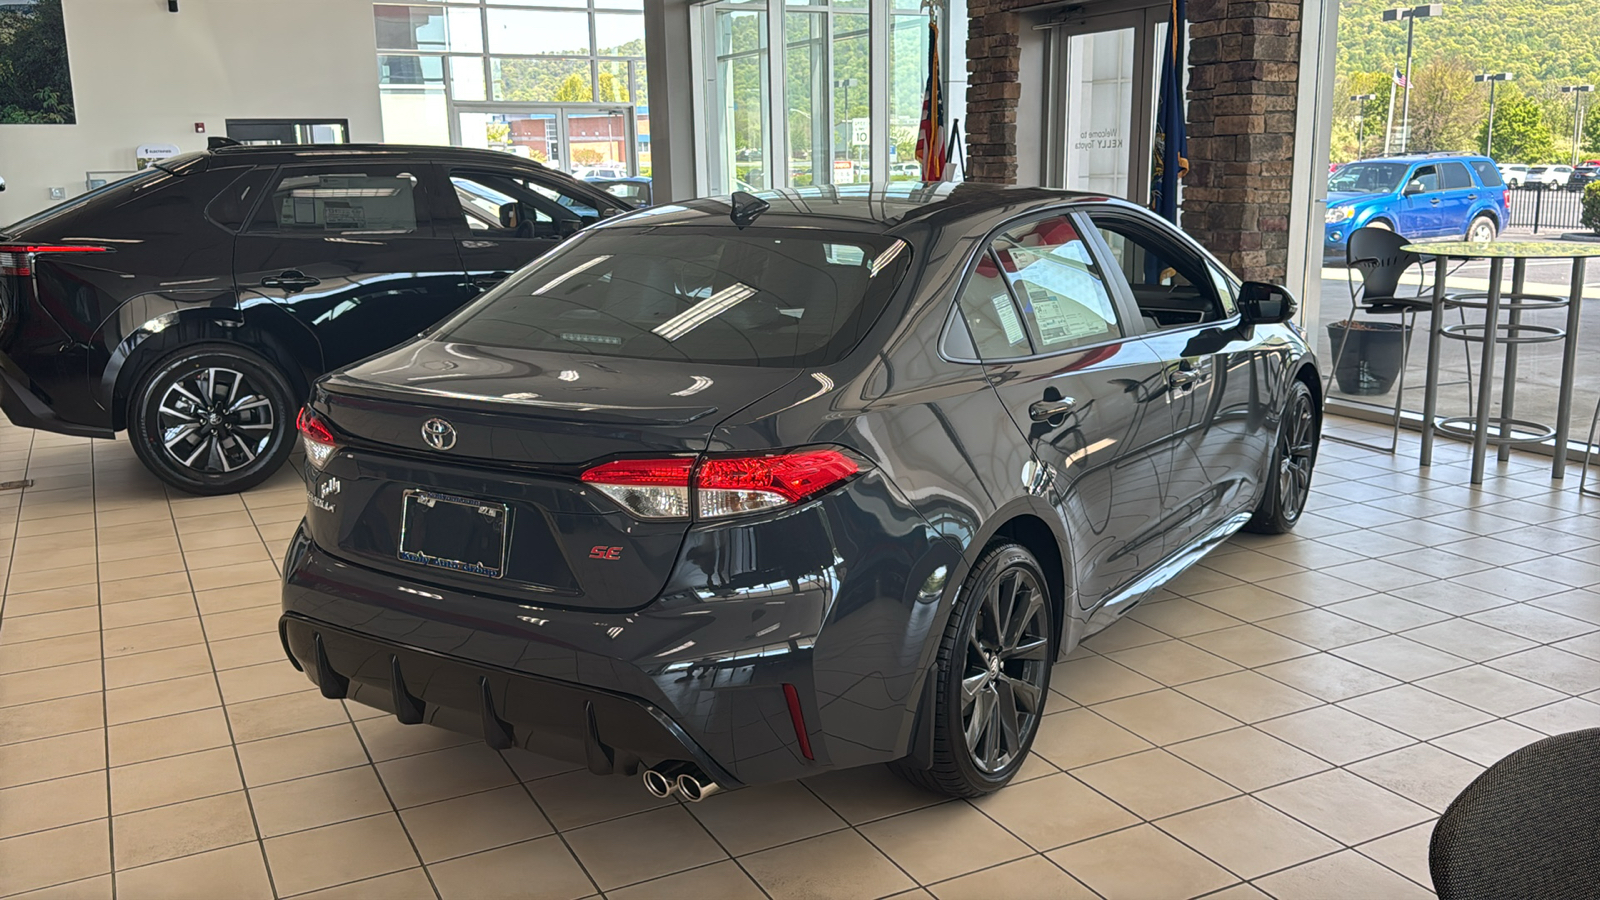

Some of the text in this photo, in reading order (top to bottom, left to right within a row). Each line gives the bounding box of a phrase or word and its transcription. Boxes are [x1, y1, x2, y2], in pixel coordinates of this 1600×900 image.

[856, 132, 867, 142] 10
[401, 552, 430, 566] Kelly
[589, 545, 623, 560] SE
